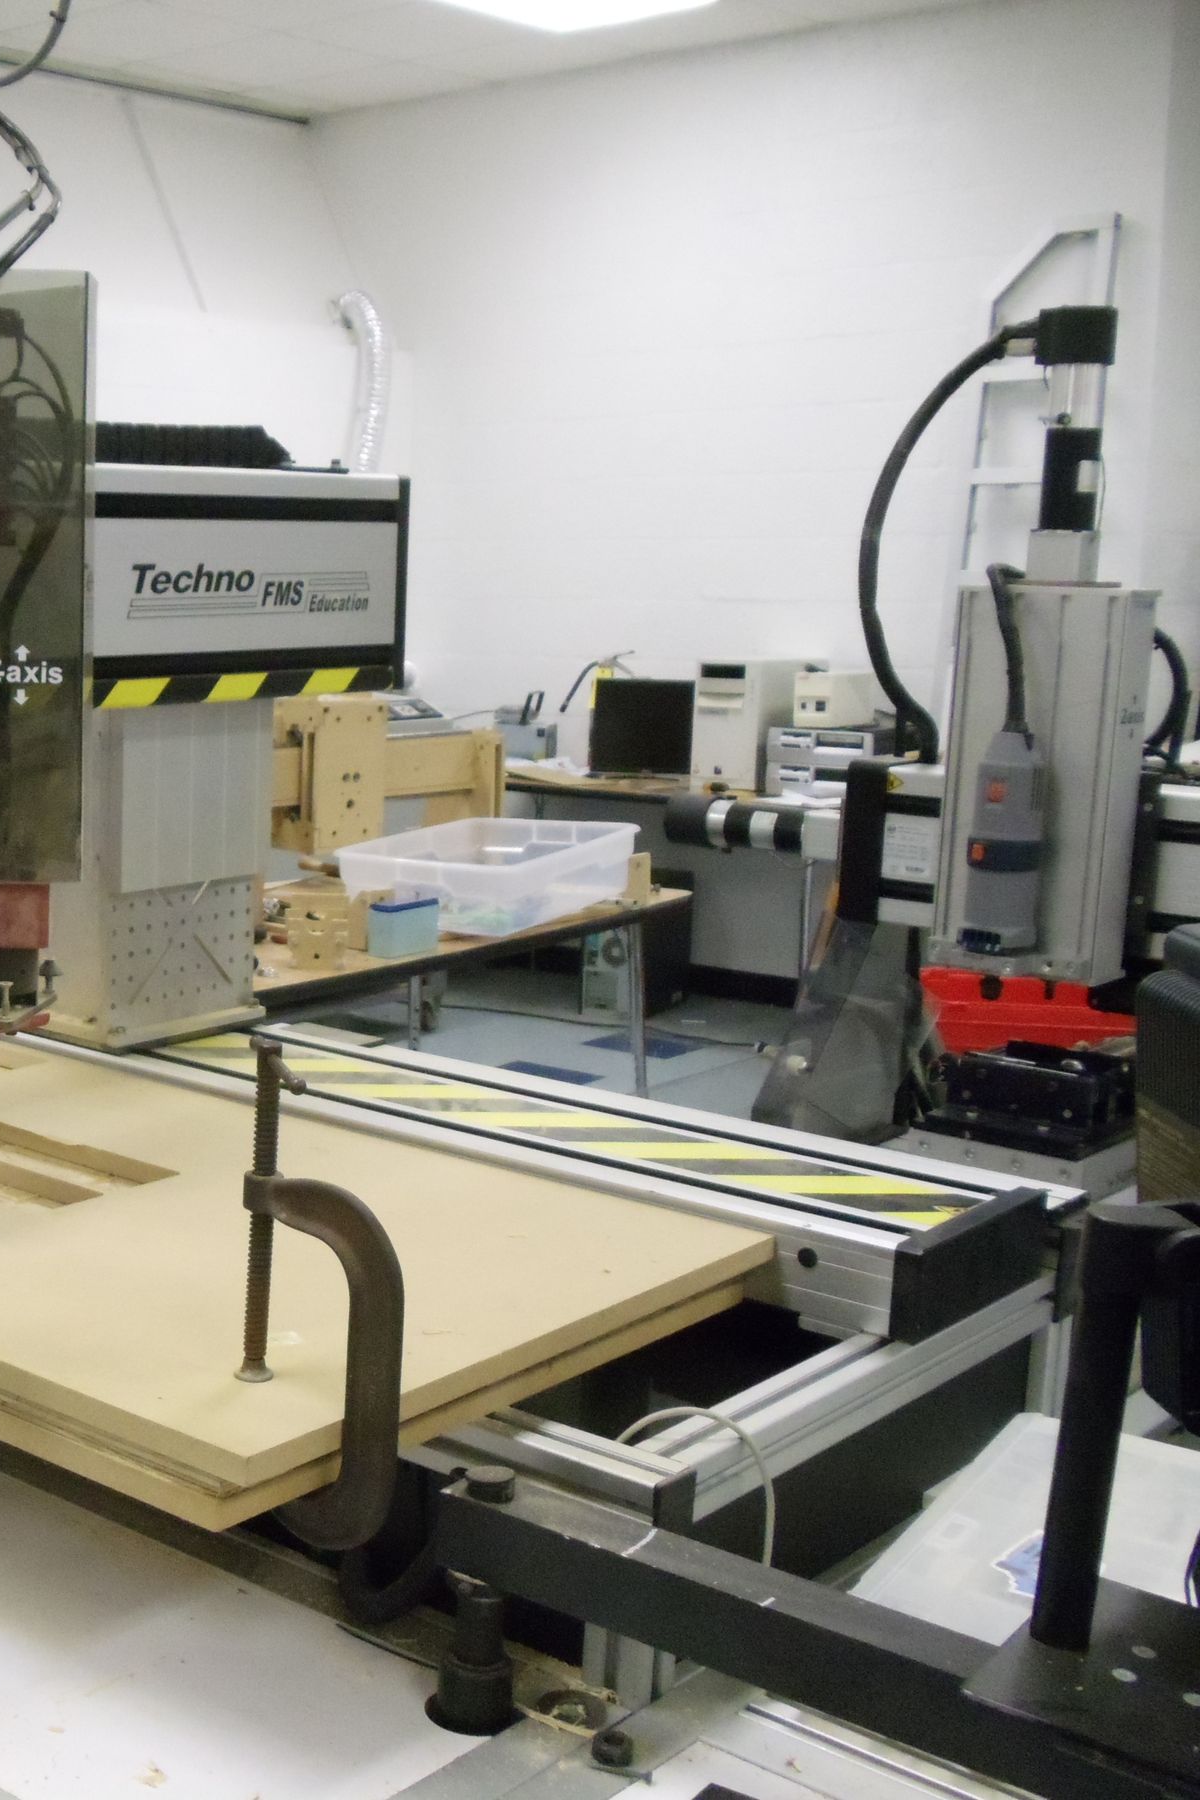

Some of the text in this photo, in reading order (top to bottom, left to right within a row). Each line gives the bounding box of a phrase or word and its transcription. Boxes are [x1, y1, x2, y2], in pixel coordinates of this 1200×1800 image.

[132, 563, 369, 613] Techno FMS Education
